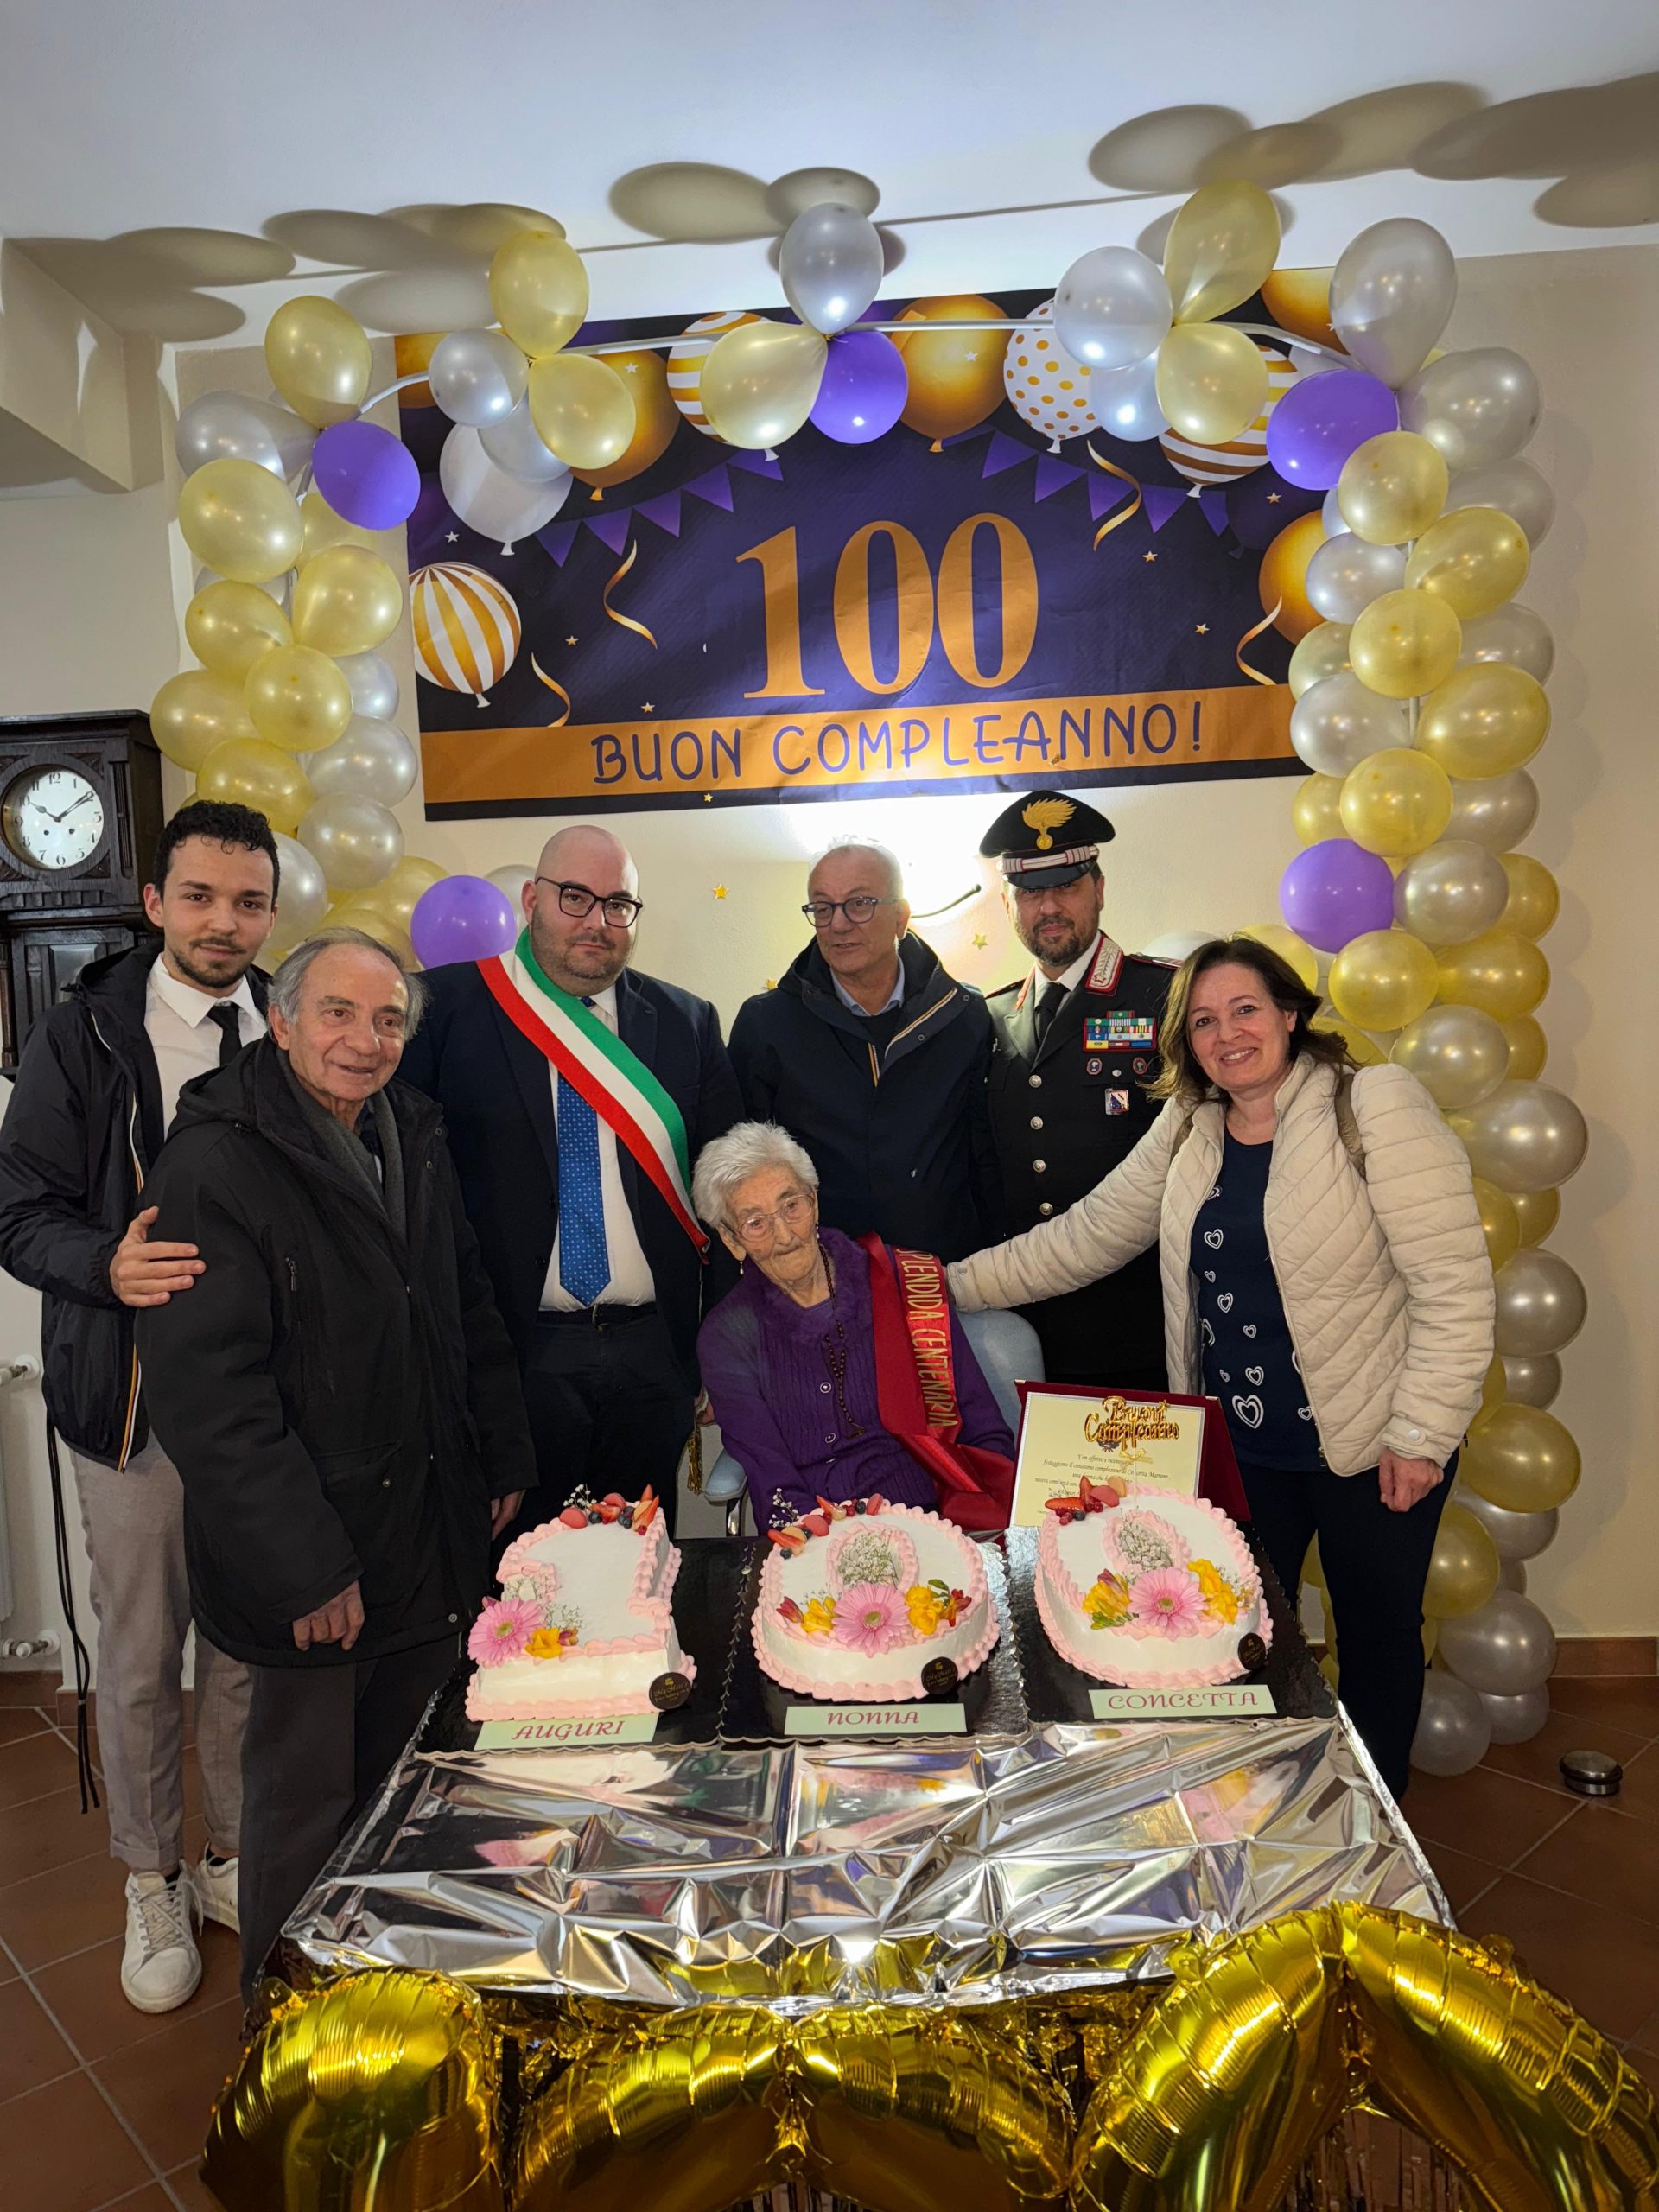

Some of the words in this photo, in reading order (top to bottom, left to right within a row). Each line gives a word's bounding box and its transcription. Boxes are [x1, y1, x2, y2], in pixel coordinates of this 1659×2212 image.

[735, 512, 1039, 699] 100
[591, 727, 743, 785] BUON
[772, 701, 1203, 777] COMPLEANNO!
[31, 780, 40, 791] 11
[48, 772, 61, 785] 12
[39, 849, 47, 861] 7
[56, 855, 66, 865] 6
[912, 1328, 958, 1427] CENTENARIA
[1108, 1692, 1258, 1709] CONCETTA
[827, 1711, 919, 1726] NONNA
[512, 1720, 626, 1741] AUGURI
